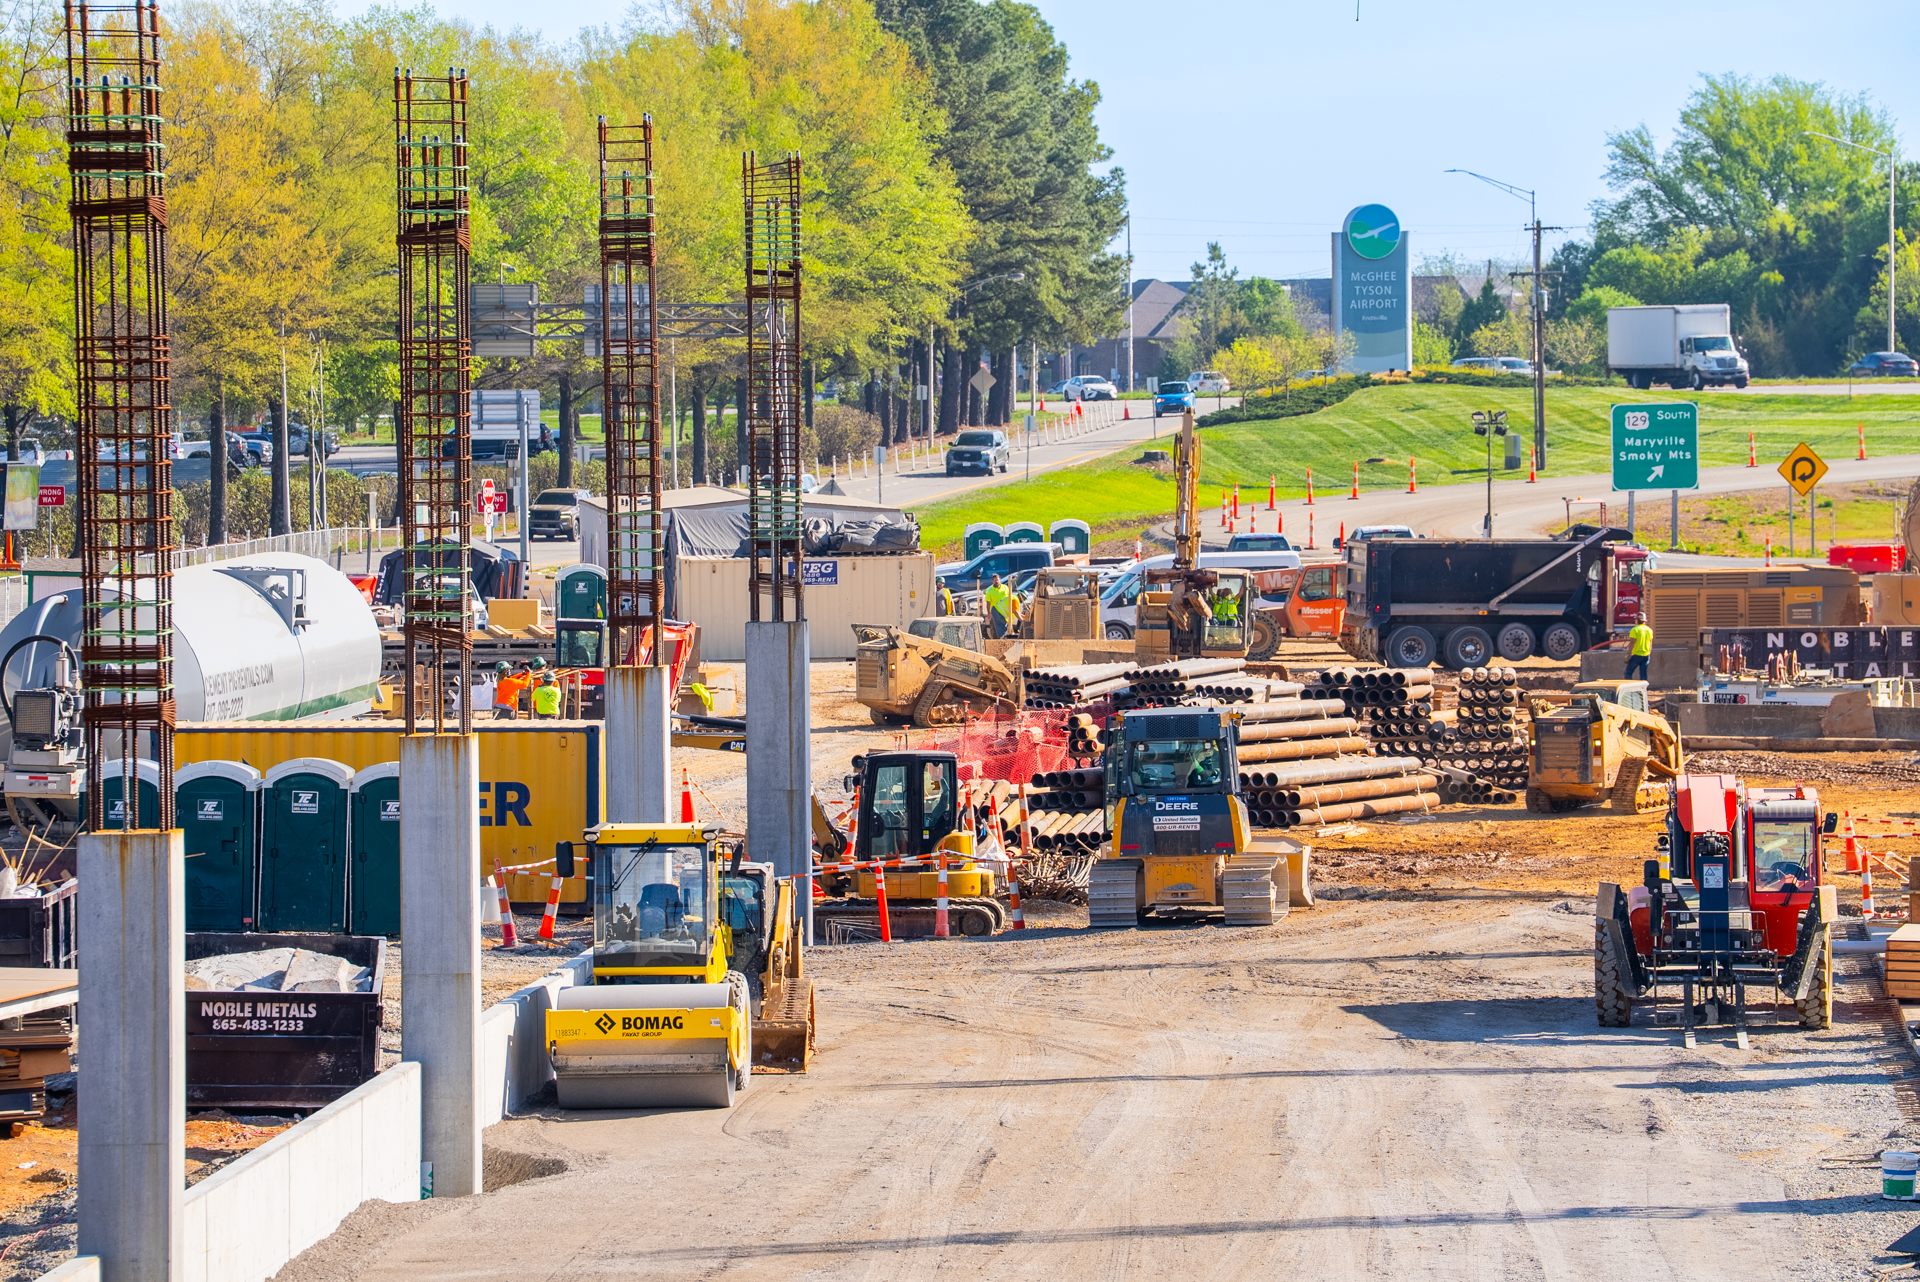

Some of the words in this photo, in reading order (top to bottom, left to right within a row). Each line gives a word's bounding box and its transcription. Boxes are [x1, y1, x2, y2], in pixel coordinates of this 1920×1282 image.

[1350, 271, 1397, 282] McGHEE
[1354, 285, 1392, 296] TYSON
[1349, 298, 1398, 310] AIRPORT
[1626, 415, 1648, 427] 129
[1624, 436, 1686, 449] Maryville
[1619, 450, 1662, 463] Smoky
[1668, 450, 1692, 460] Mts
[1302, 607, 1333, 615] Messer
[1766, 631, 1914, 649] NOBLE
[568, 682, 596, 691] Msser
[730, 740, 745, 752] CAT
[1156, 802, 1198, 811] DEERE
[201, 1001, 253, 1017] NOBLE
[256, 1002, 317, 1018] METALS
[212, 1019, 304, 1031] 865-483-1233
[622, 1016, 683, 1030] BOMAG
